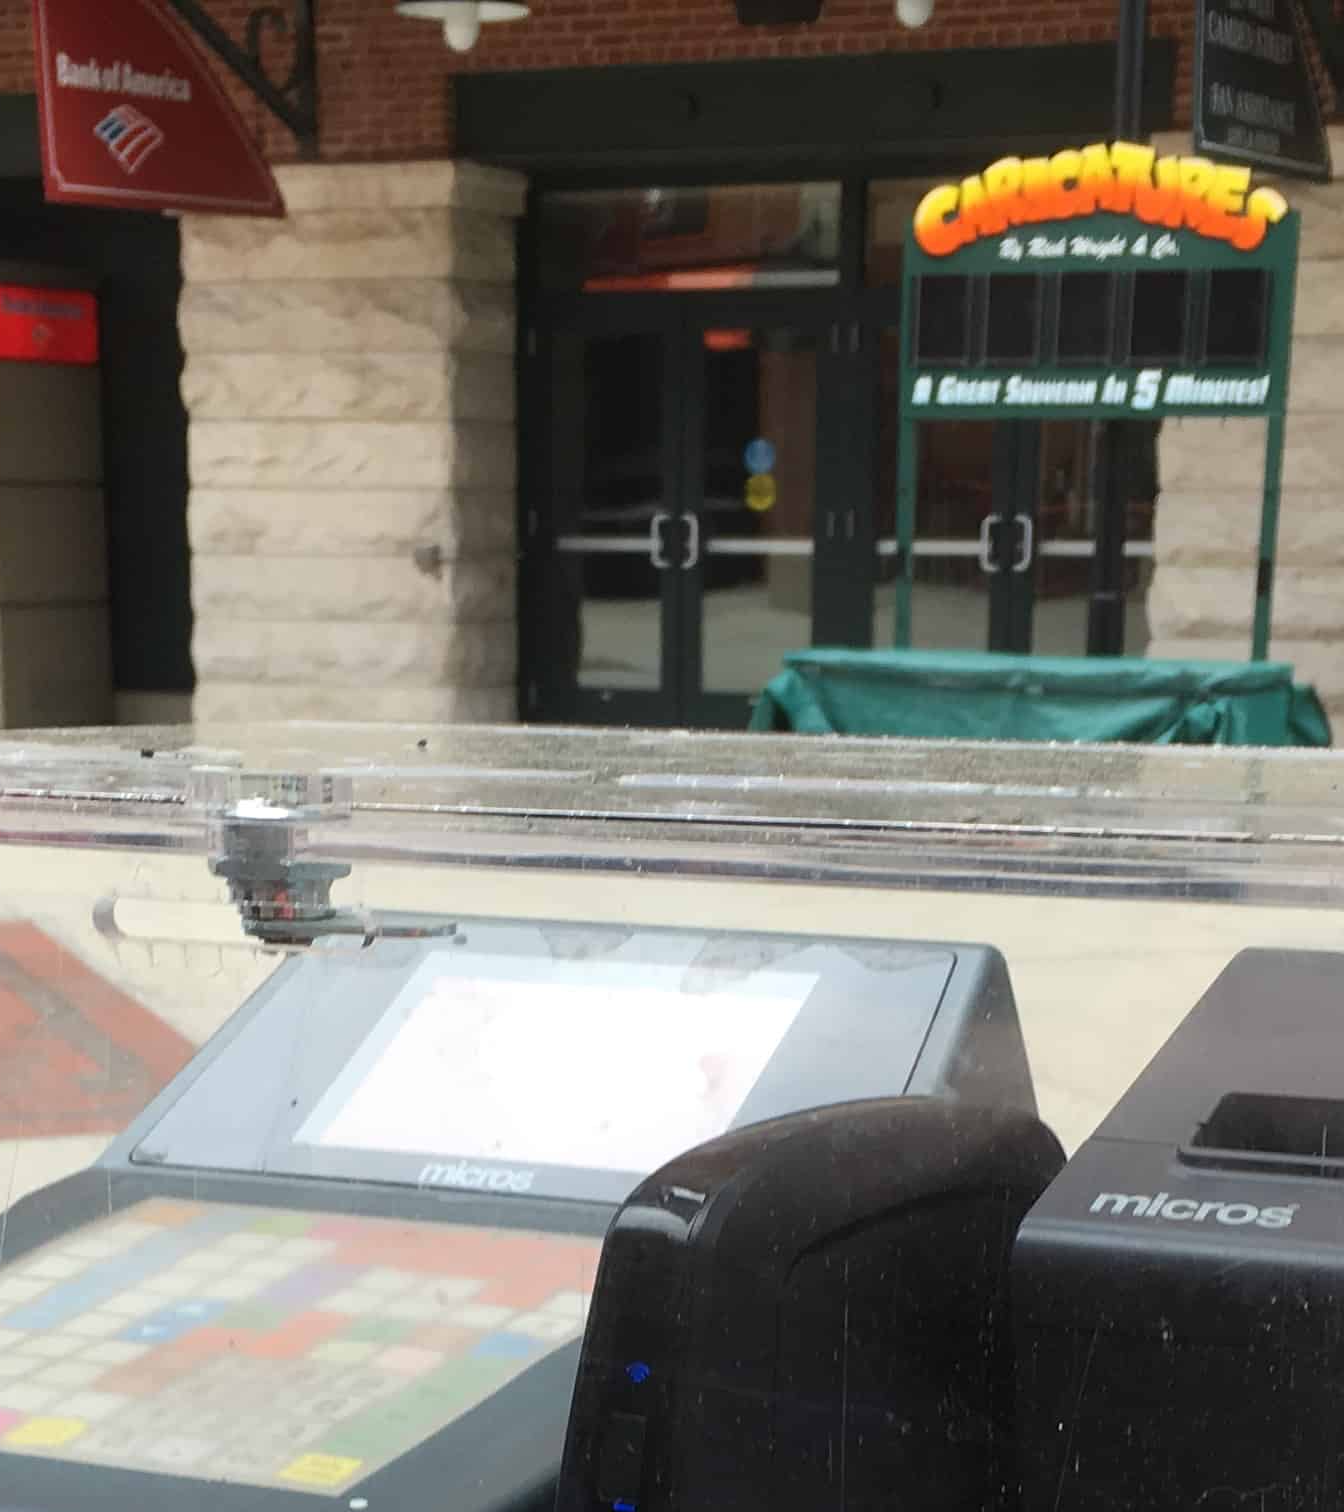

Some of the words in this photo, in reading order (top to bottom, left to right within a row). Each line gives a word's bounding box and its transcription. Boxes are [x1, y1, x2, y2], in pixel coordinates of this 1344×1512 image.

[56, 51, 99, 91] Bank
[102, 60, 121, 93] of
[122, 61, 192, 102] America
[913, 140, 1289, 257] CARICATURES
[1131, 369, 1163, 411] 5
[417, 1159, 536, 1192] micros
[1089, 1191, 1297, 1229] micros
